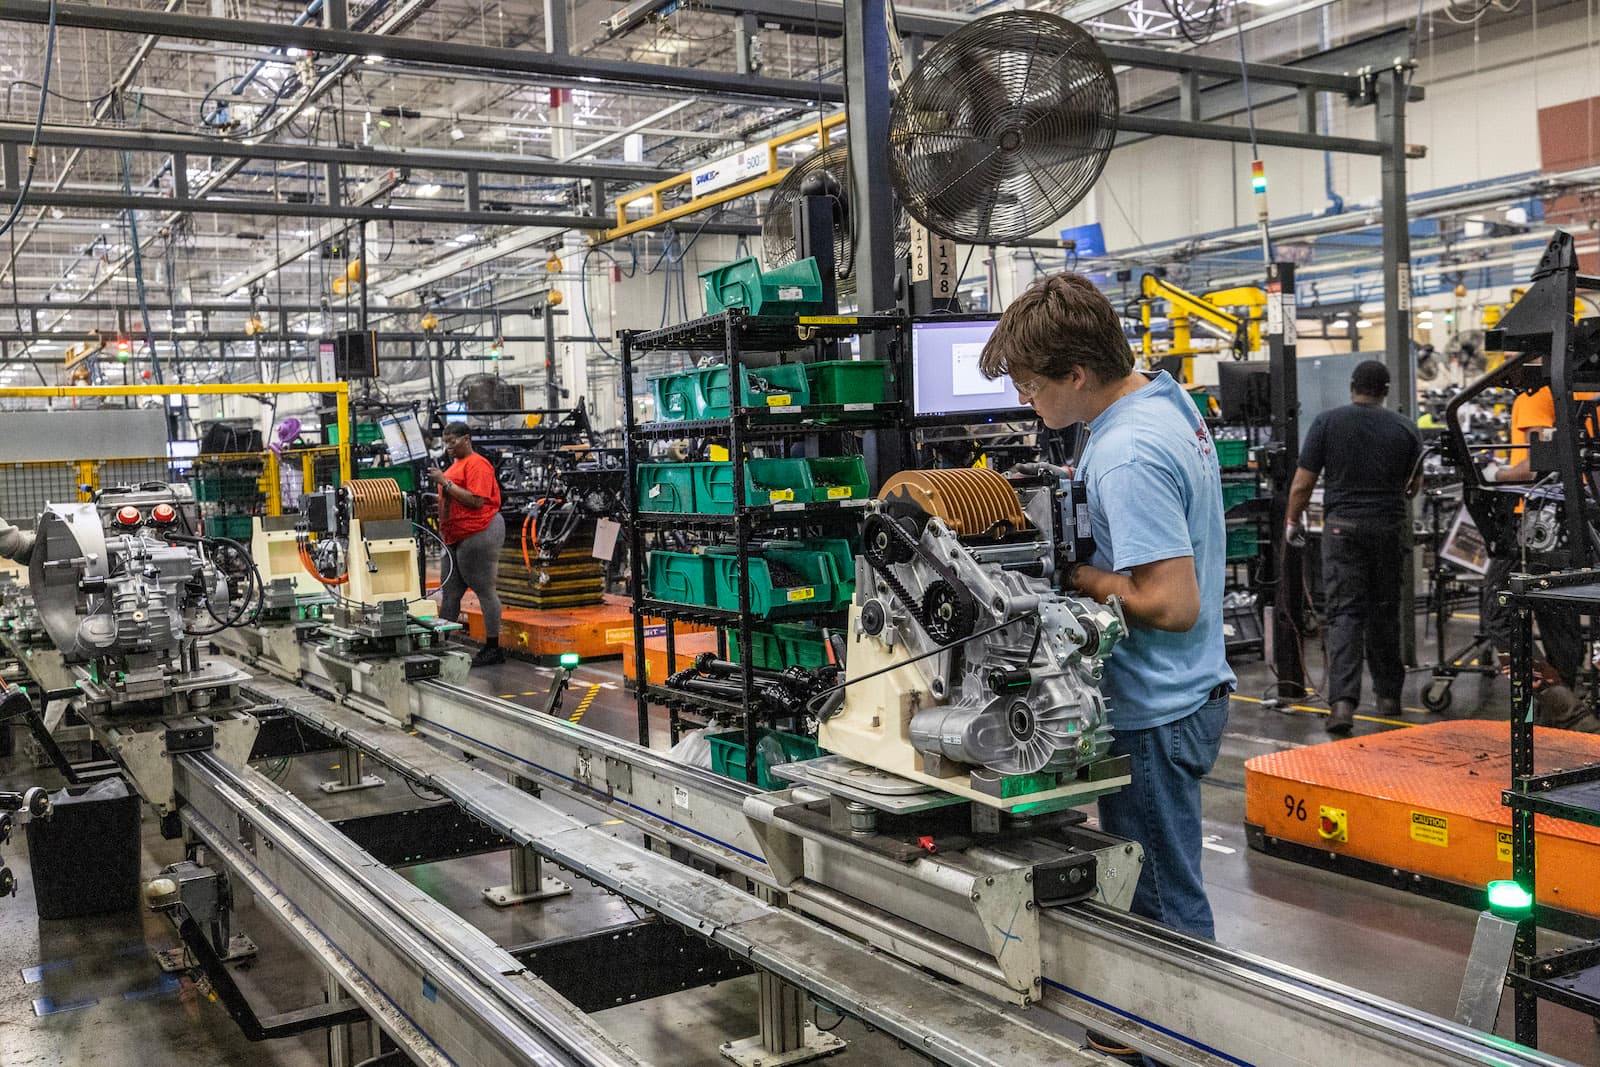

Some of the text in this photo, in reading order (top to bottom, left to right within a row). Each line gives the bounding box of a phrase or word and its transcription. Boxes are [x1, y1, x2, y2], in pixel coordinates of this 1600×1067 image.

[747, 155, 760, 169] 500
[1284, 794, 1307, 821] 96
[1413, 814, 1446, 828] CAUTION
